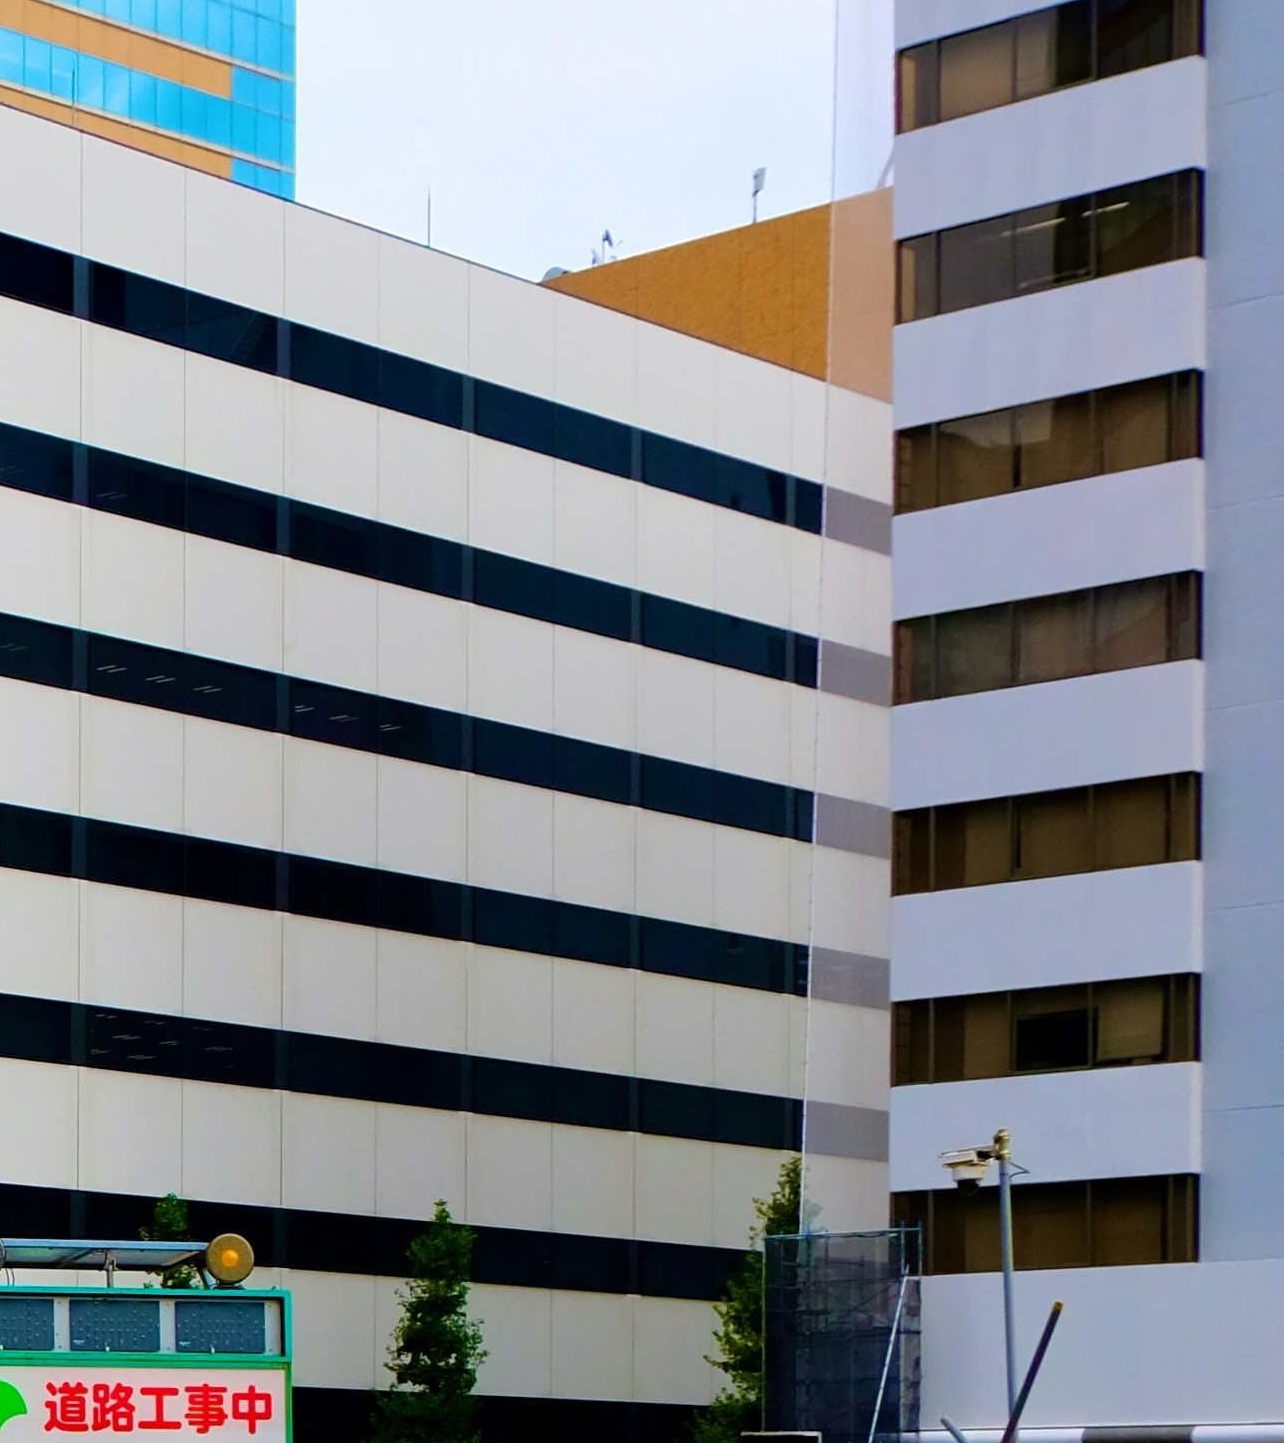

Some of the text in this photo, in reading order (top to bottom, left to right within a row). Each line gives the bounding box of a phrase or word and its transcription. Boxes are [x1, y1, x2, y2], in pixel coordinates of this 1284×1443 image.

[44, 1381, 273, 1435] 道路工事中
